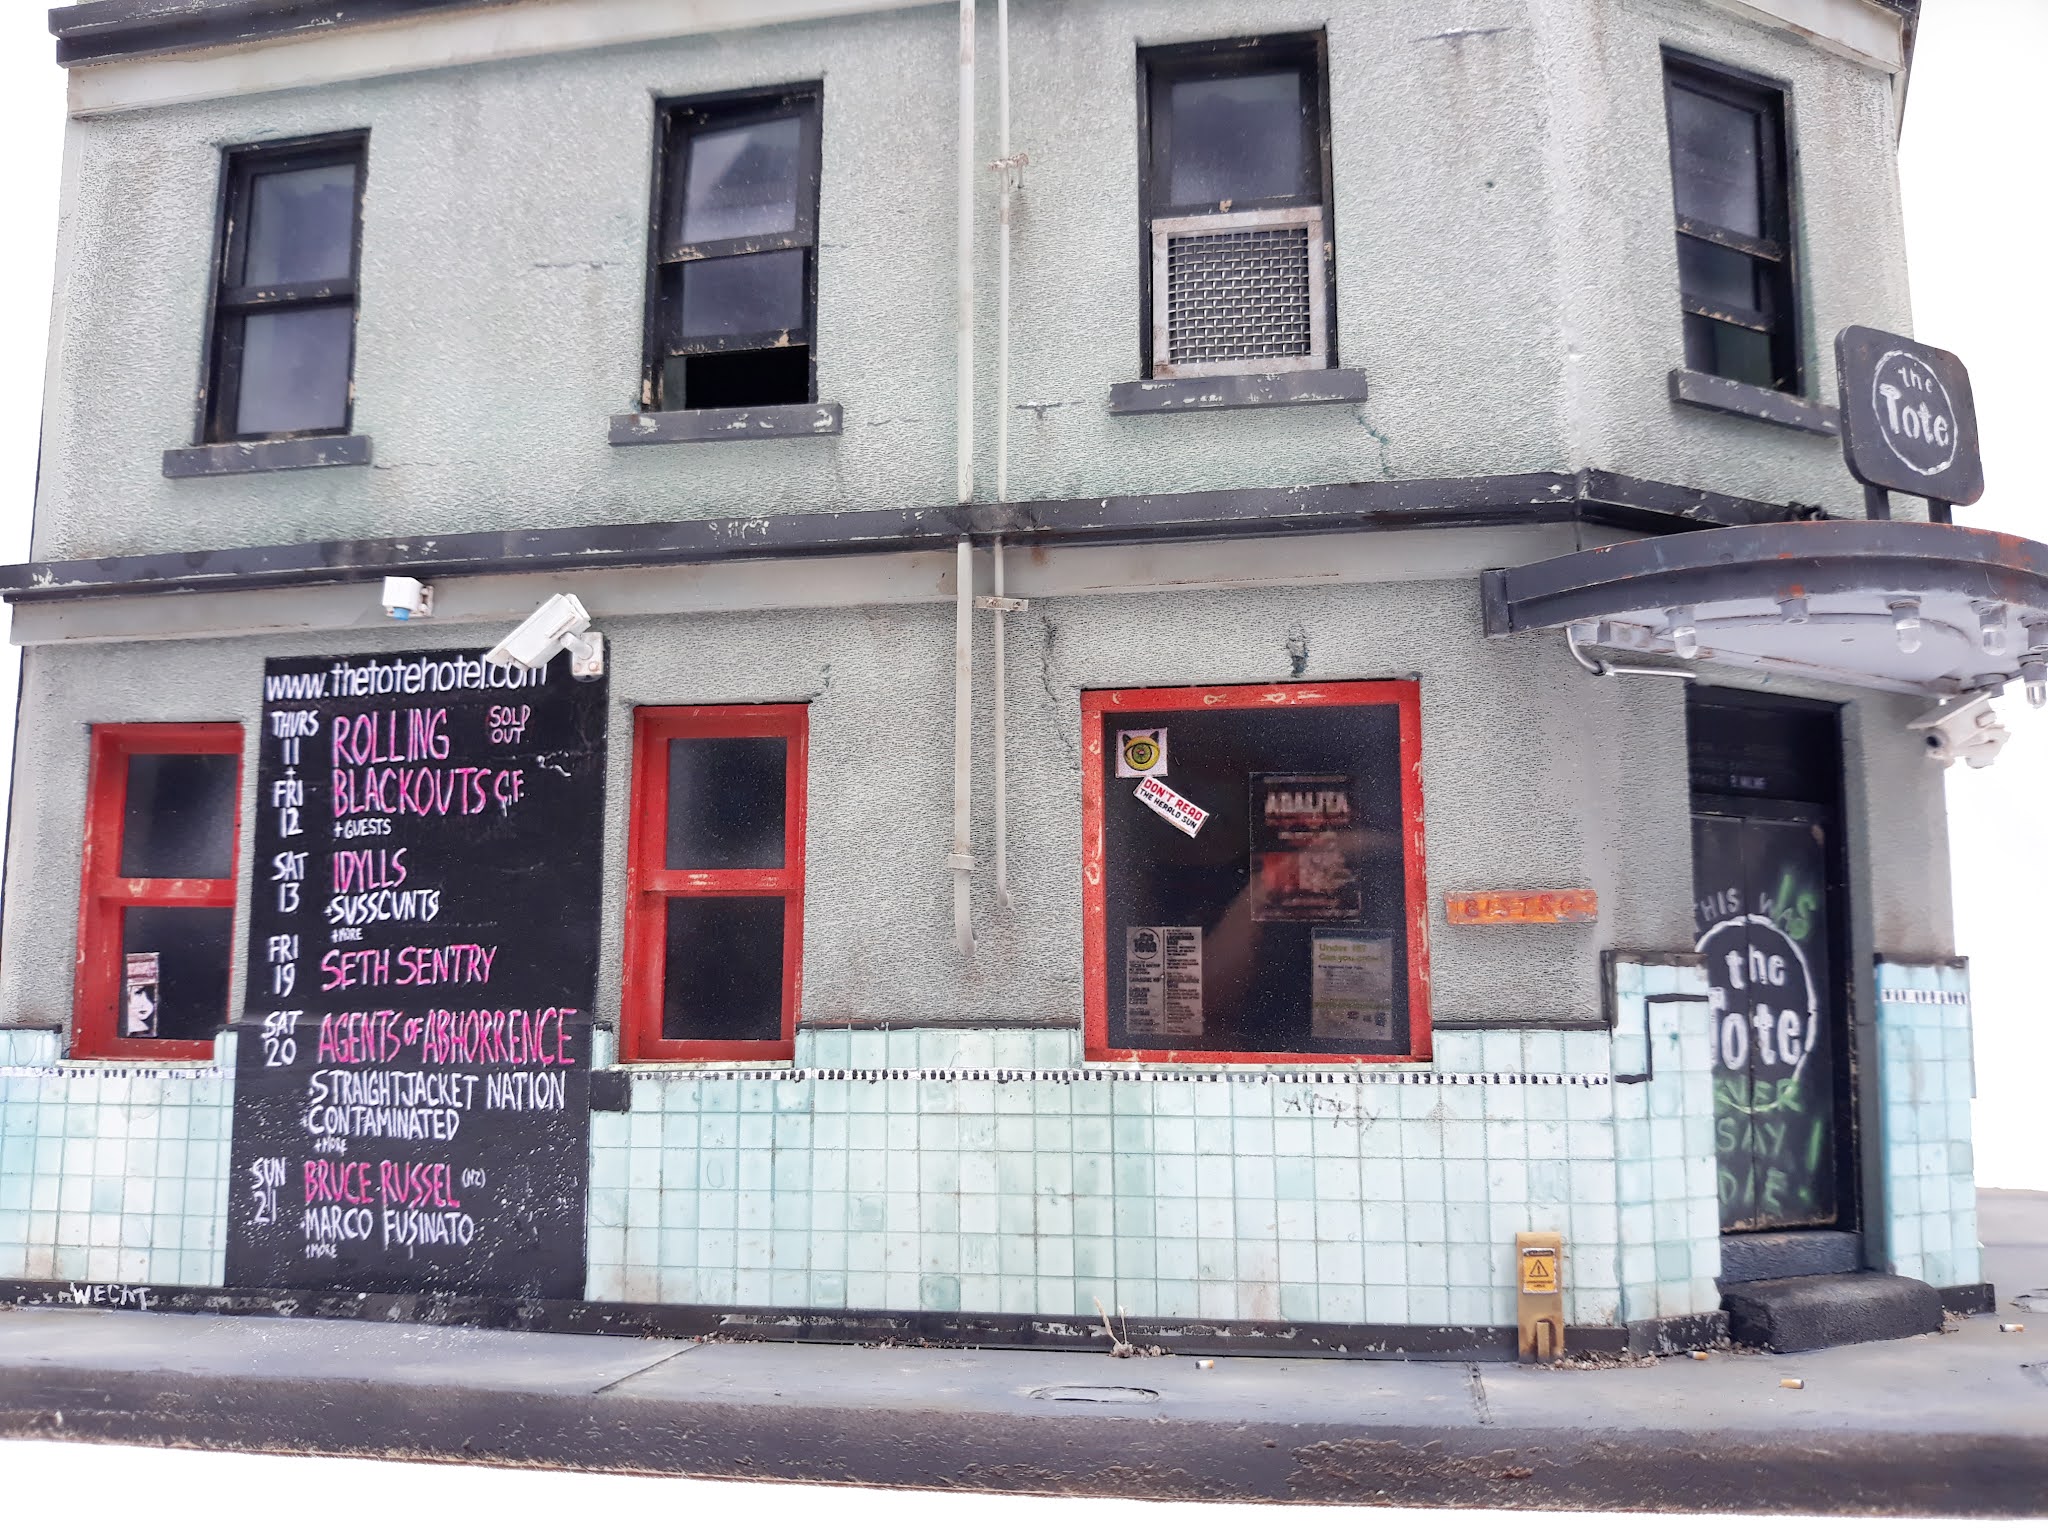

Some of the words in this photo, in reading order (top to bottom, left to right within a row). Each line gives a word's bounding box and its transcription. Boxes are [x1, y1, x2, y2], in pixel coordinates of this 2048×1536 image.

[1898, 366, 1933, 393] the
[1879, 383, 1949, 447] Tote
[271, 710, 320, 738] THURS
[489, 705, 531, 731] SOLD
[492, 726, 525, 744] OUT
[281, 739, 300, 766] 11
[332, 708, 450, 767] ROLLING
[274, 779, 304, 807] FRI
[333, 767, 491, 818] BLACKOUTS
[1139, 788, 1154, 801] THE
[1153, 797, 1181, 819] HERALD
[1180, 815, 1198, 829] SUN
[1143, 779, 1176, 803] DON'T
[1174, 799, 1203, 821] READ
[280, 807, 303, 838] 12
[270, 851, 309, 881] SAT
[333, 848, 408, 894] IDYLLS
[278, 881, 300, 913] 13
[1695, 887, 1740, 922] HIS
[269, 934, 299, 964] FRI
[272, 962, 297, 998] 19
[320, 948, 391, 992] SETH
[395, 943, 498, 986] SENTRY
[1724, 944, 1786, 990] the
[262, 1011, 303, 1039] SAT
[317, 1010, 403, 1064] AGENTS
[403, 1017, 425, 1046] OF
[422, 1008, 577, 1065] ABHORRENCE
[264, 1036, 297, 1067] 20
[308, 1069, 479, 1111] STRAIGHTJACKET
[484, 1070, 567, 1112] NATION
[308, 1105, 460, 1141] CONTAMINATED
[1716, 1116, 1786, 1156] SAY
[251, 1157, 286, 1190] SUN
[303, 1159, 375, 1205] BRUCE
[380, 1159, 461, 1208] RUSSEL
[253, 1190, 277, 1225] 21
[303, 1205, 374, 1241] MARCO
[383, 1208, 475, 1250] FUSINATO
